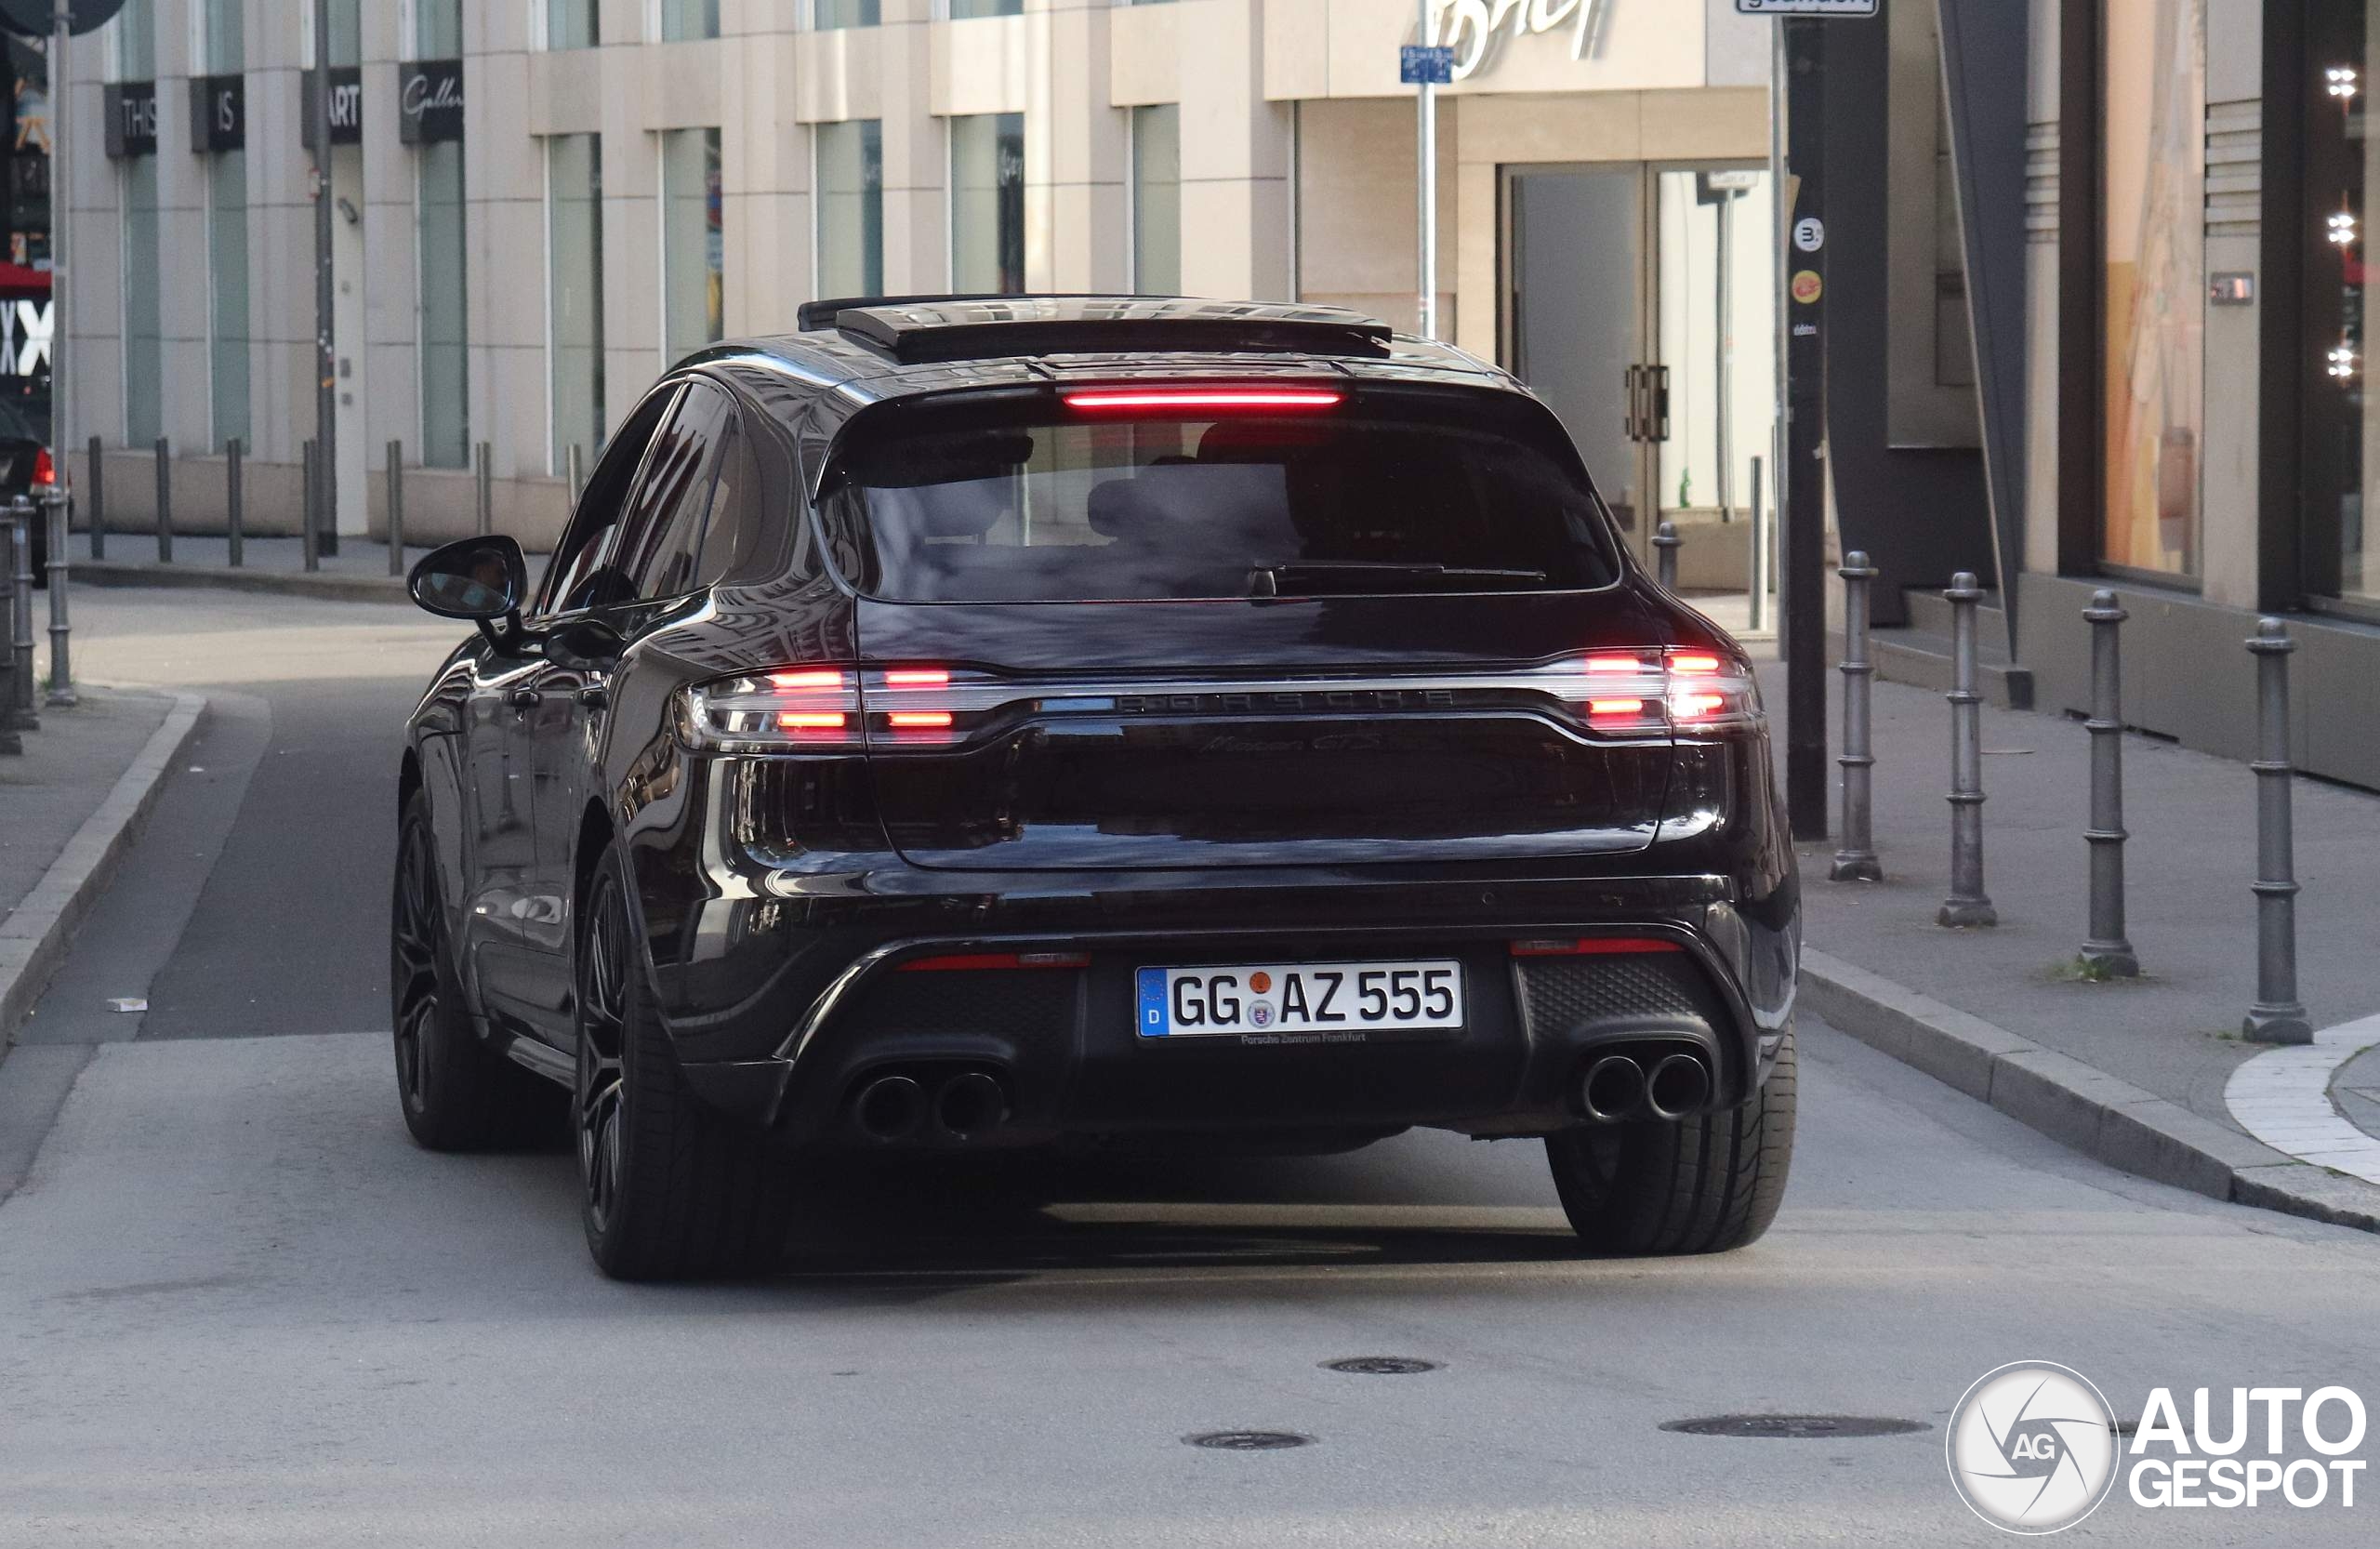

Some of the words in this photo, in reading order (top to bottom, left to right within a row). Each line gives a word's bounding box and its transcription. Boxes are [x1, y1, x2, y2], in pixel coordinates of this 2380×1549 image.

[218, 91, 235, 132] IS
[1173, 975, 1241, 1026] GG
[1280, 973, 1346, 1023] AZ
[1358, 970, 1454, 1021] 555
[1148, 1010, 1160, 1024] D
[1240, 1035, 1280, 1045] Porsche
[1281, 1034, 1320, 1044] Zentrum
[1322, 1032, 1366, 1043] Frankfurt
